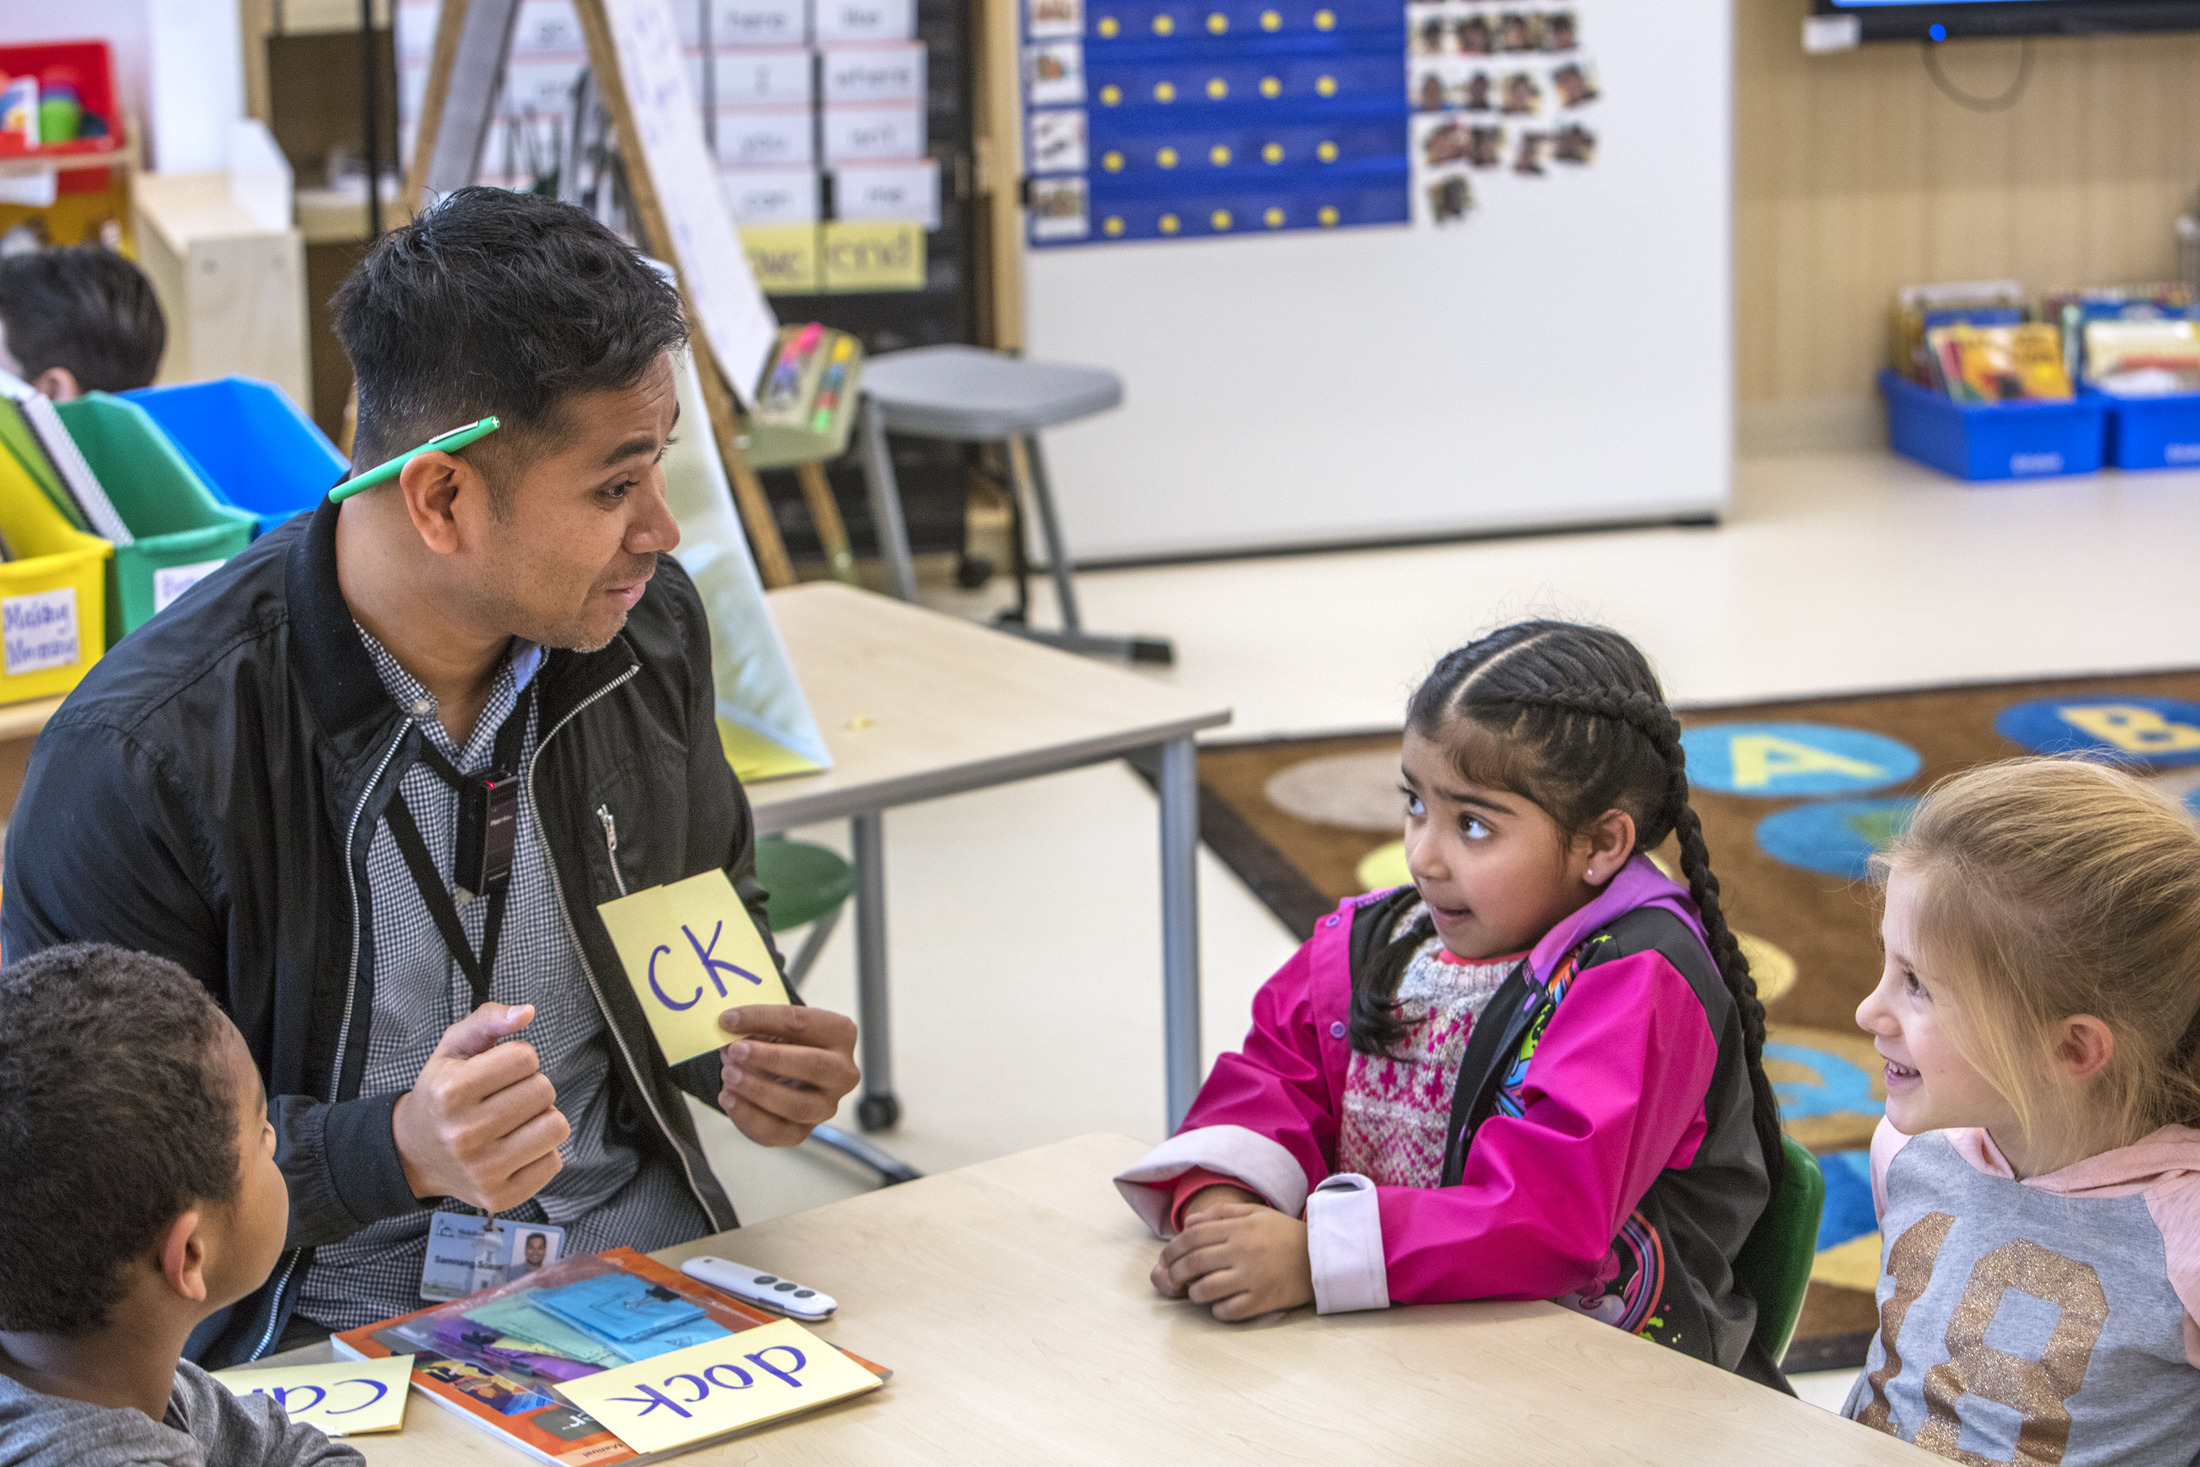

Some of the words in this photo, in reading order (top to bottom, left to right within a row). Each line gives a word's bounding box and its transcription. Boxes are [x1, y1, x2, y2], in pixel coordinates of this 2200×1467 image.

[2057, 704, 2200, 754] B
[1730, 733, 1892, 788] A
[1857, 1211, 2109, 1467] 18
[252, 1378, 388, 1415] ca
[602, 1345, 807, 1418] dock
